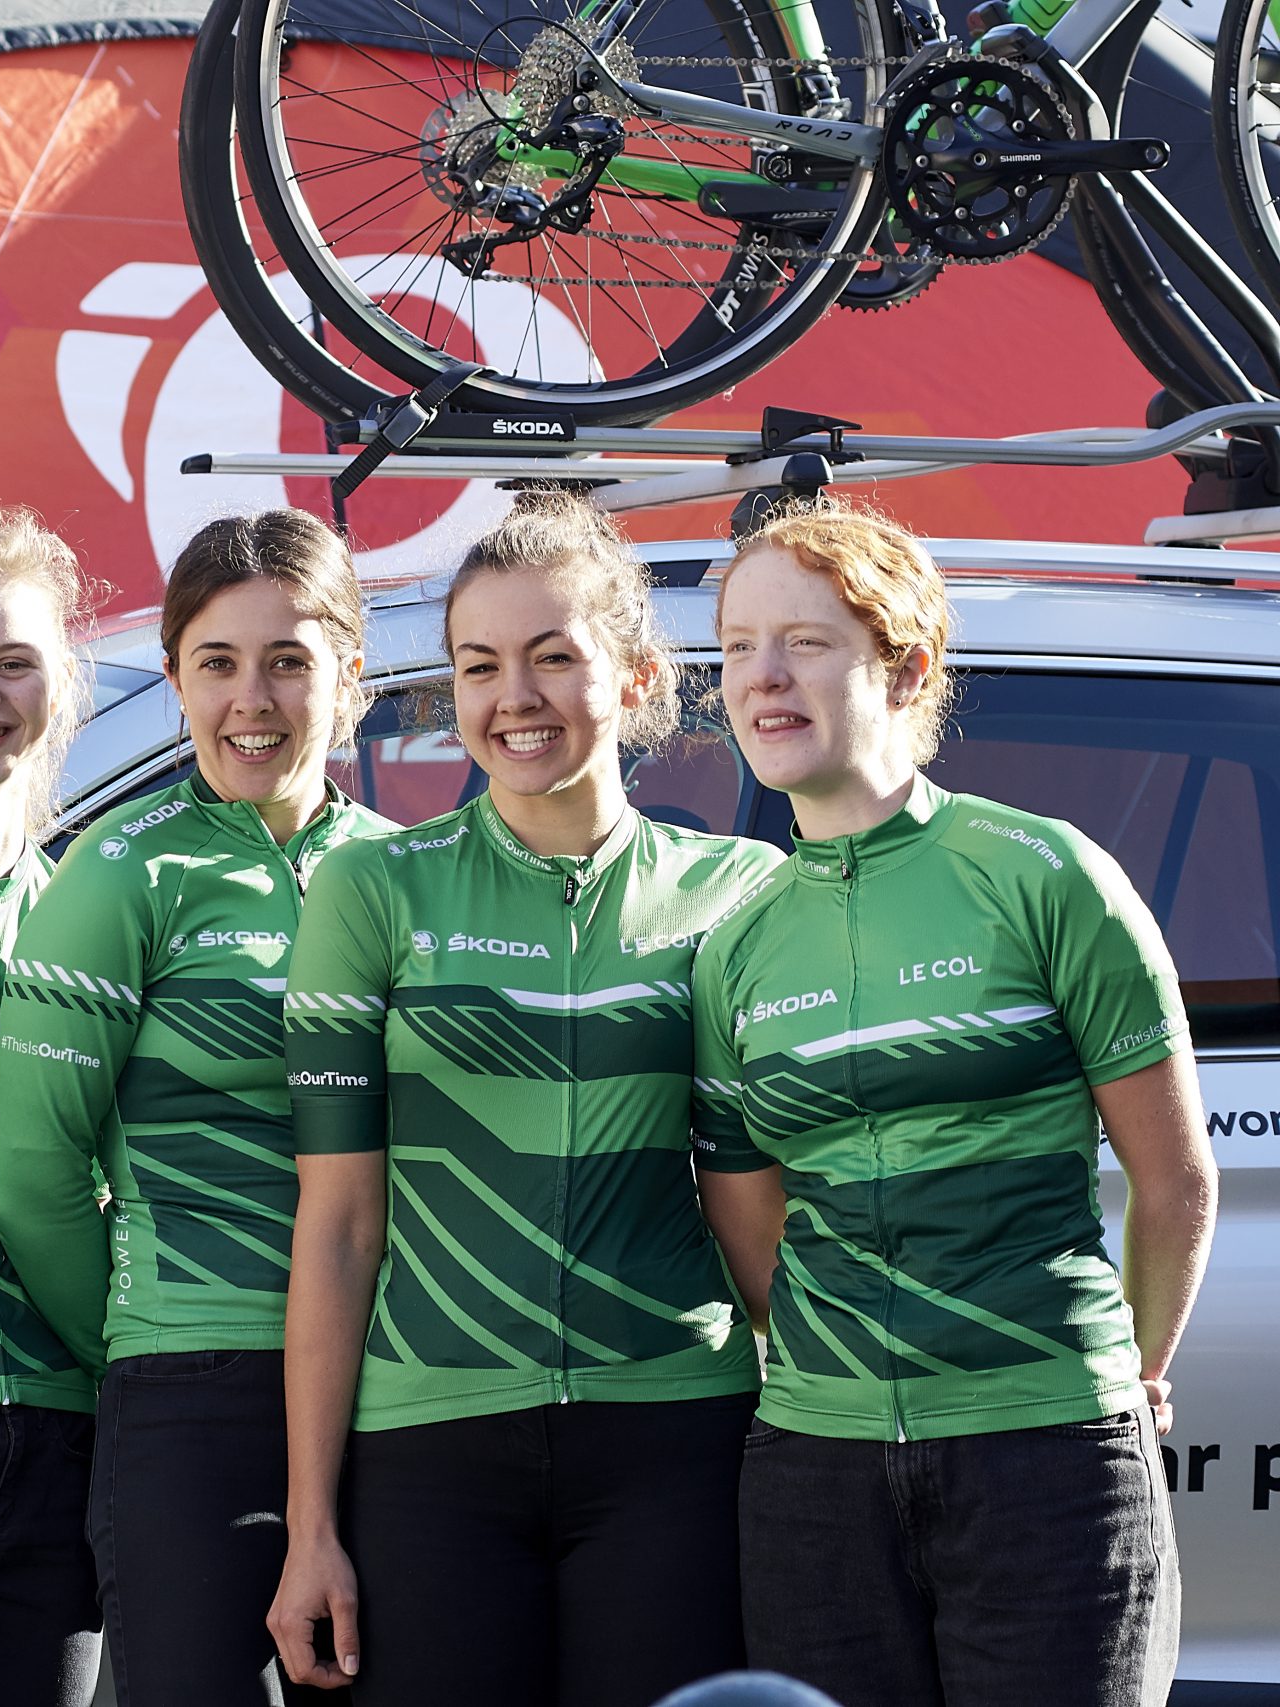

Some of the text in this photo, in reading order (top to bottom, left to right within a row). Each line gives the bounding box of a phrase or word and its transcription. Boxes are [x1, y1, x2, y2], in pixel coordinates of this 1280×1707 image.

[999, 153, 1041, 163] SHIMANO
[772, 209, 839, 220] LTEGRA
[715, 289, 742, 325] DT
[492, 419, 565, 435] ŠKODA
[120, 800, 191, 837] ŠKODA
[408, 825, 470, 852] ŠKODA
[967, 818, 1064, 871] #ThisIsOurTime
[197, 930, 292, 947] ŠKODA
[448, 933, 551, 959] ŠKODA
[620, 938, 647, 954] LE
[752, 955, 983, 1023] ŠKODA LE COL
[1, 1035, 100, 1068] #ThisIsOurTime
